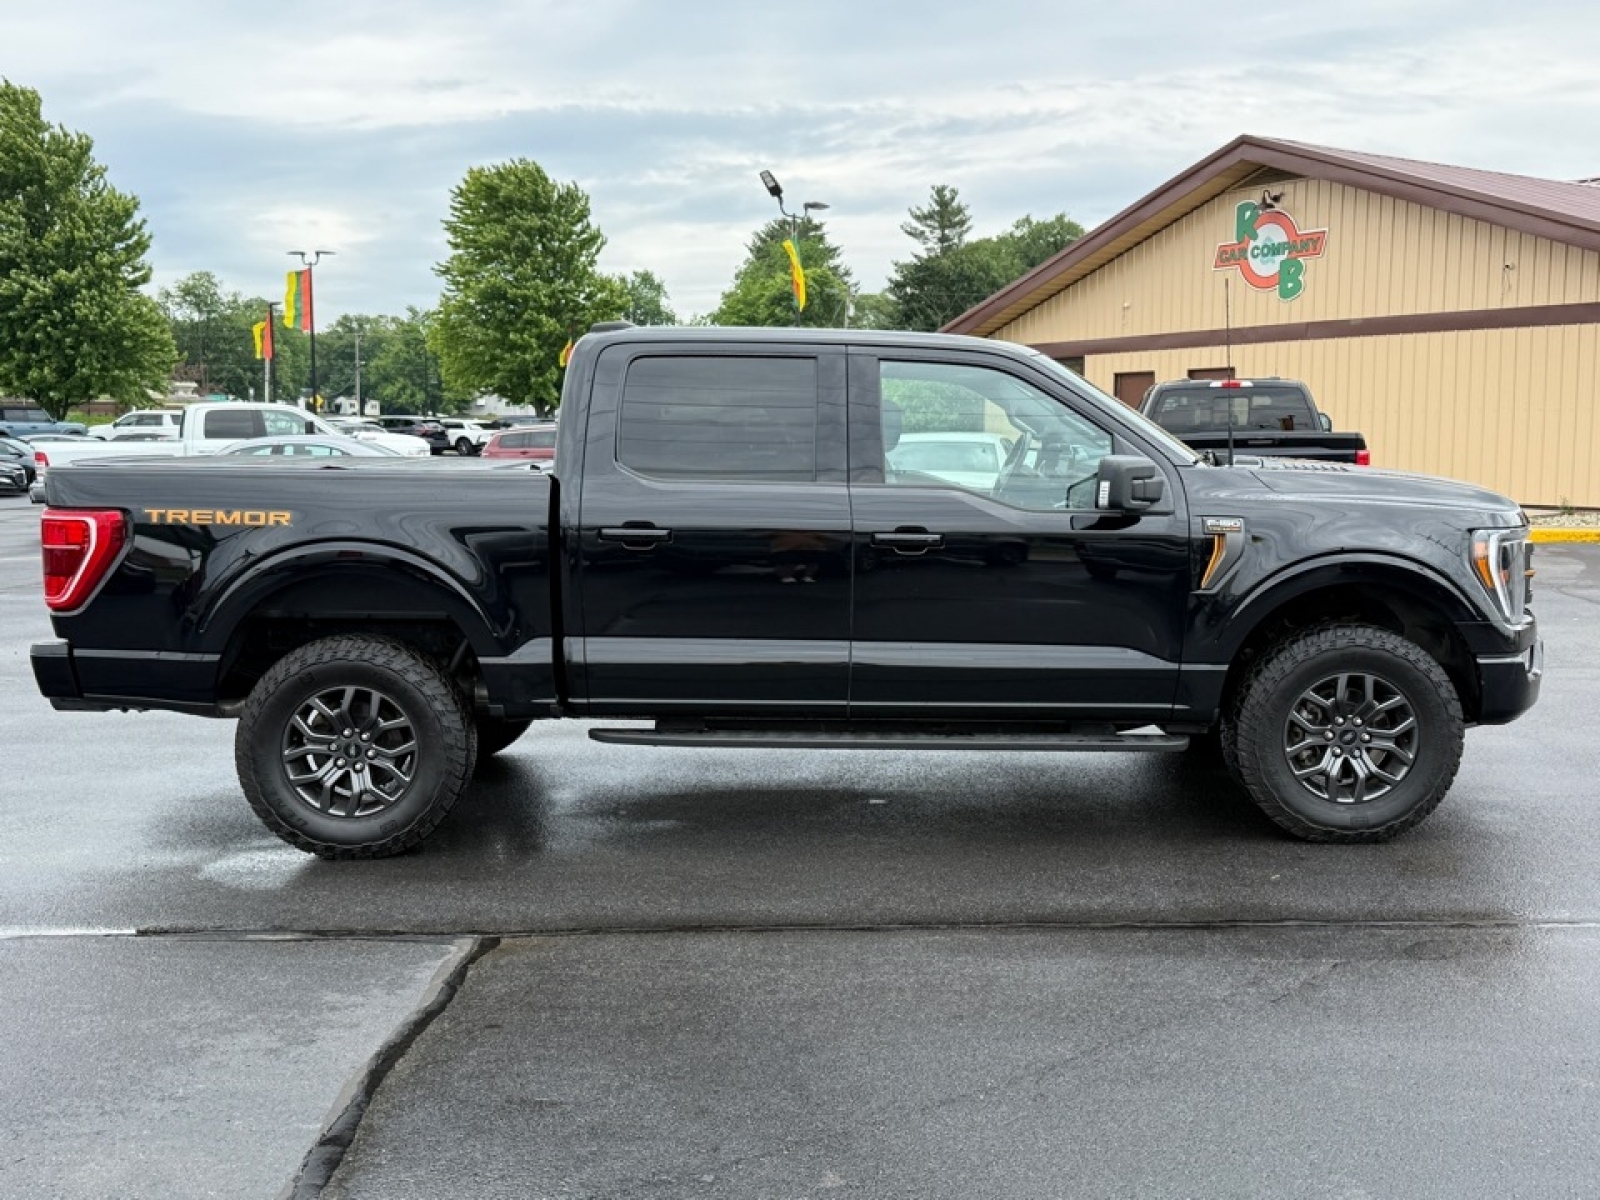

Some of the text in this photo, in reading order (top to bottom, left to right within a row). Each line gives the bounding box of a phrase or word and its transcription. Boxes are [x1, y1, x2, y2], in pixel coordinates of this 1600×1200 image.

[1236, 201, 1259, 243] R
[1218, 236, 1321, 263] CAR COMPANY
[1278, 258, 1303, 299] B
[144, 509, 291, 526] TREMOR
